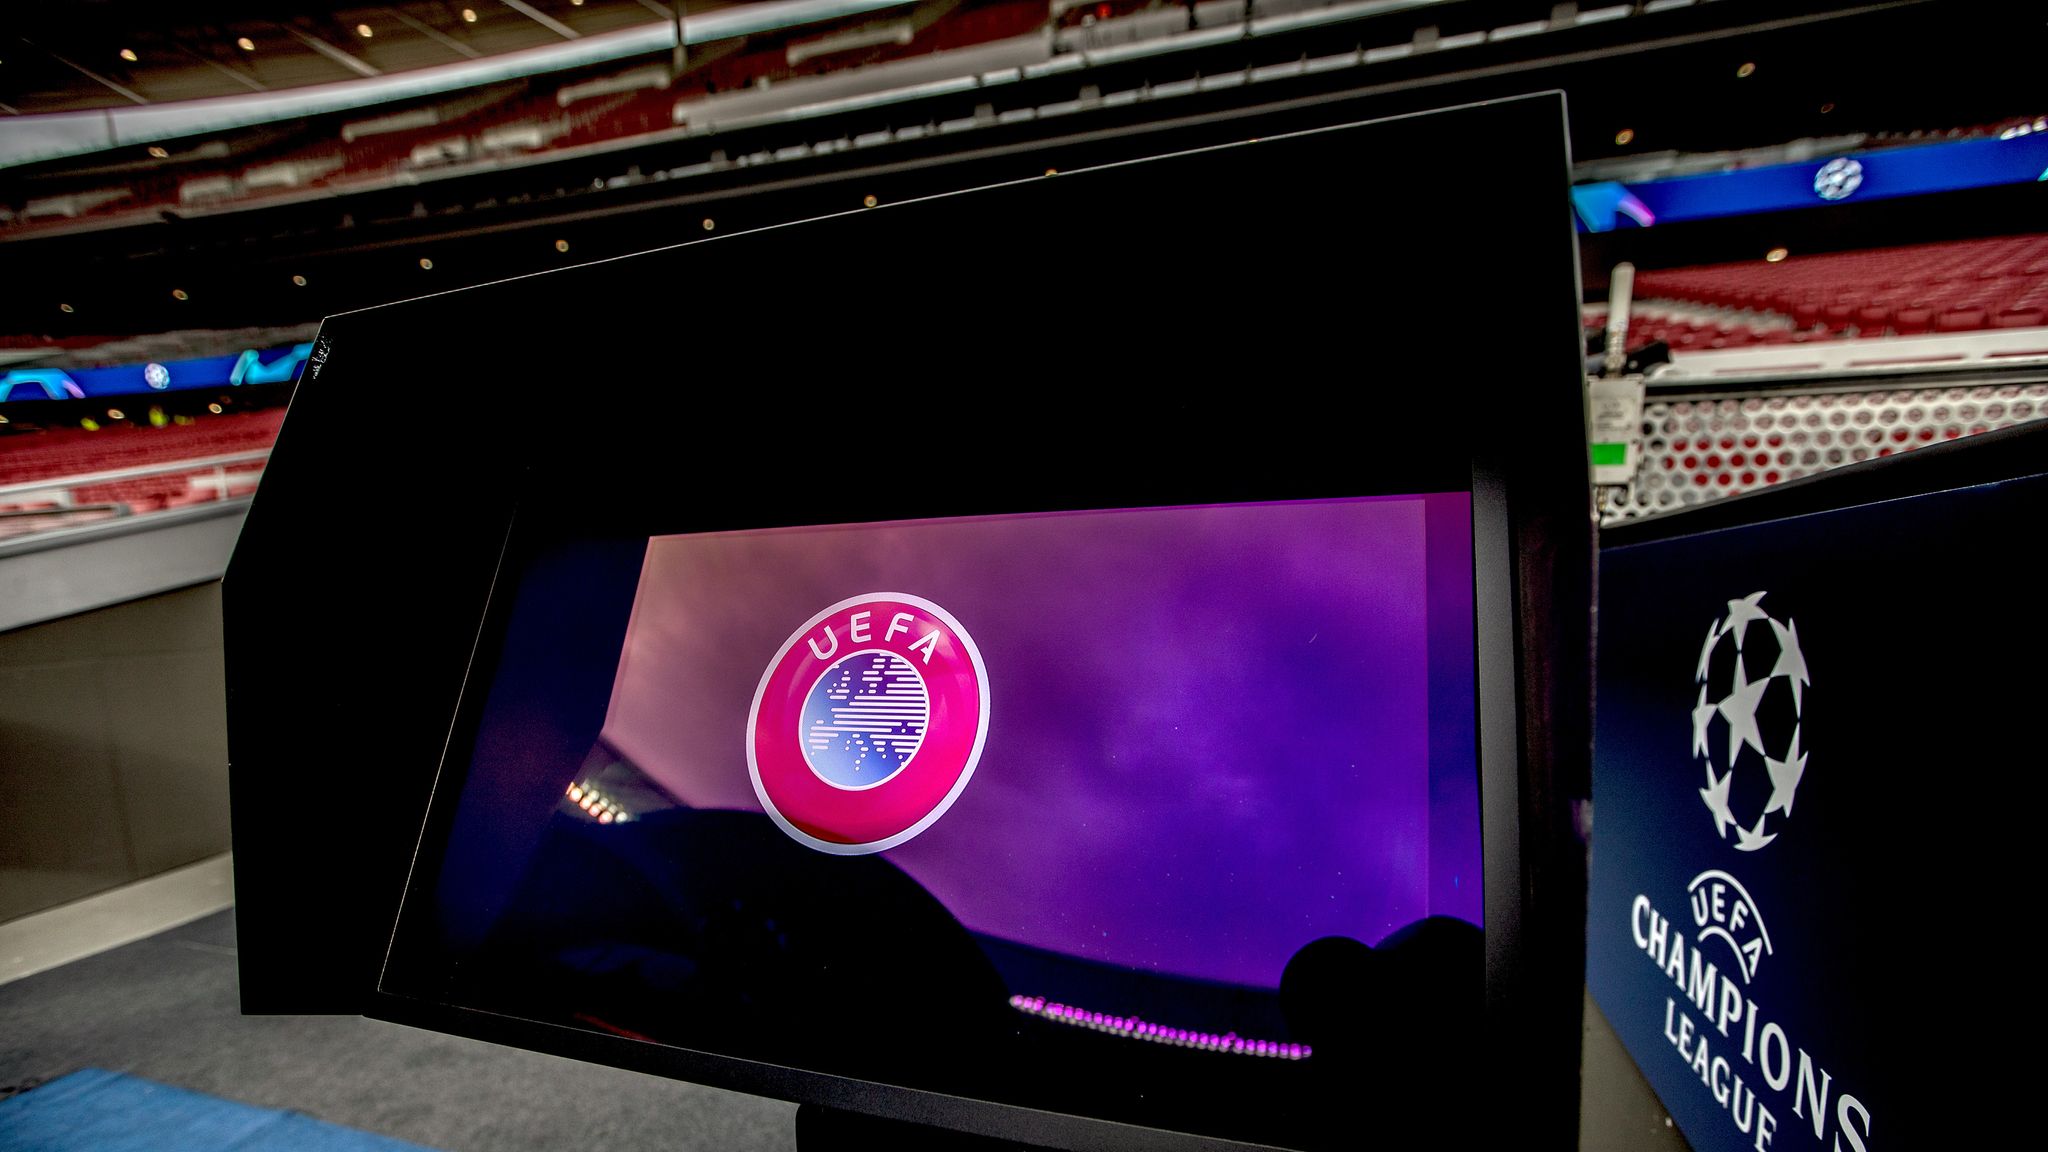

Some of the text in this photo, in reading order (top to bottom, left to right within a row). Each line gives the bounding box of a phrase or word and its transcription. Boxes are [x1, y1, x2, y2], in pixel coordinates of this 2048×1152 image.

[808, 611, 941, 665] UEFA
[1691, 883, 1762, 977] UEFA
[1632, 895, 1871, 1152] CHAMPIONS
[1665, 998, 1776, 1152] LEAGUE
